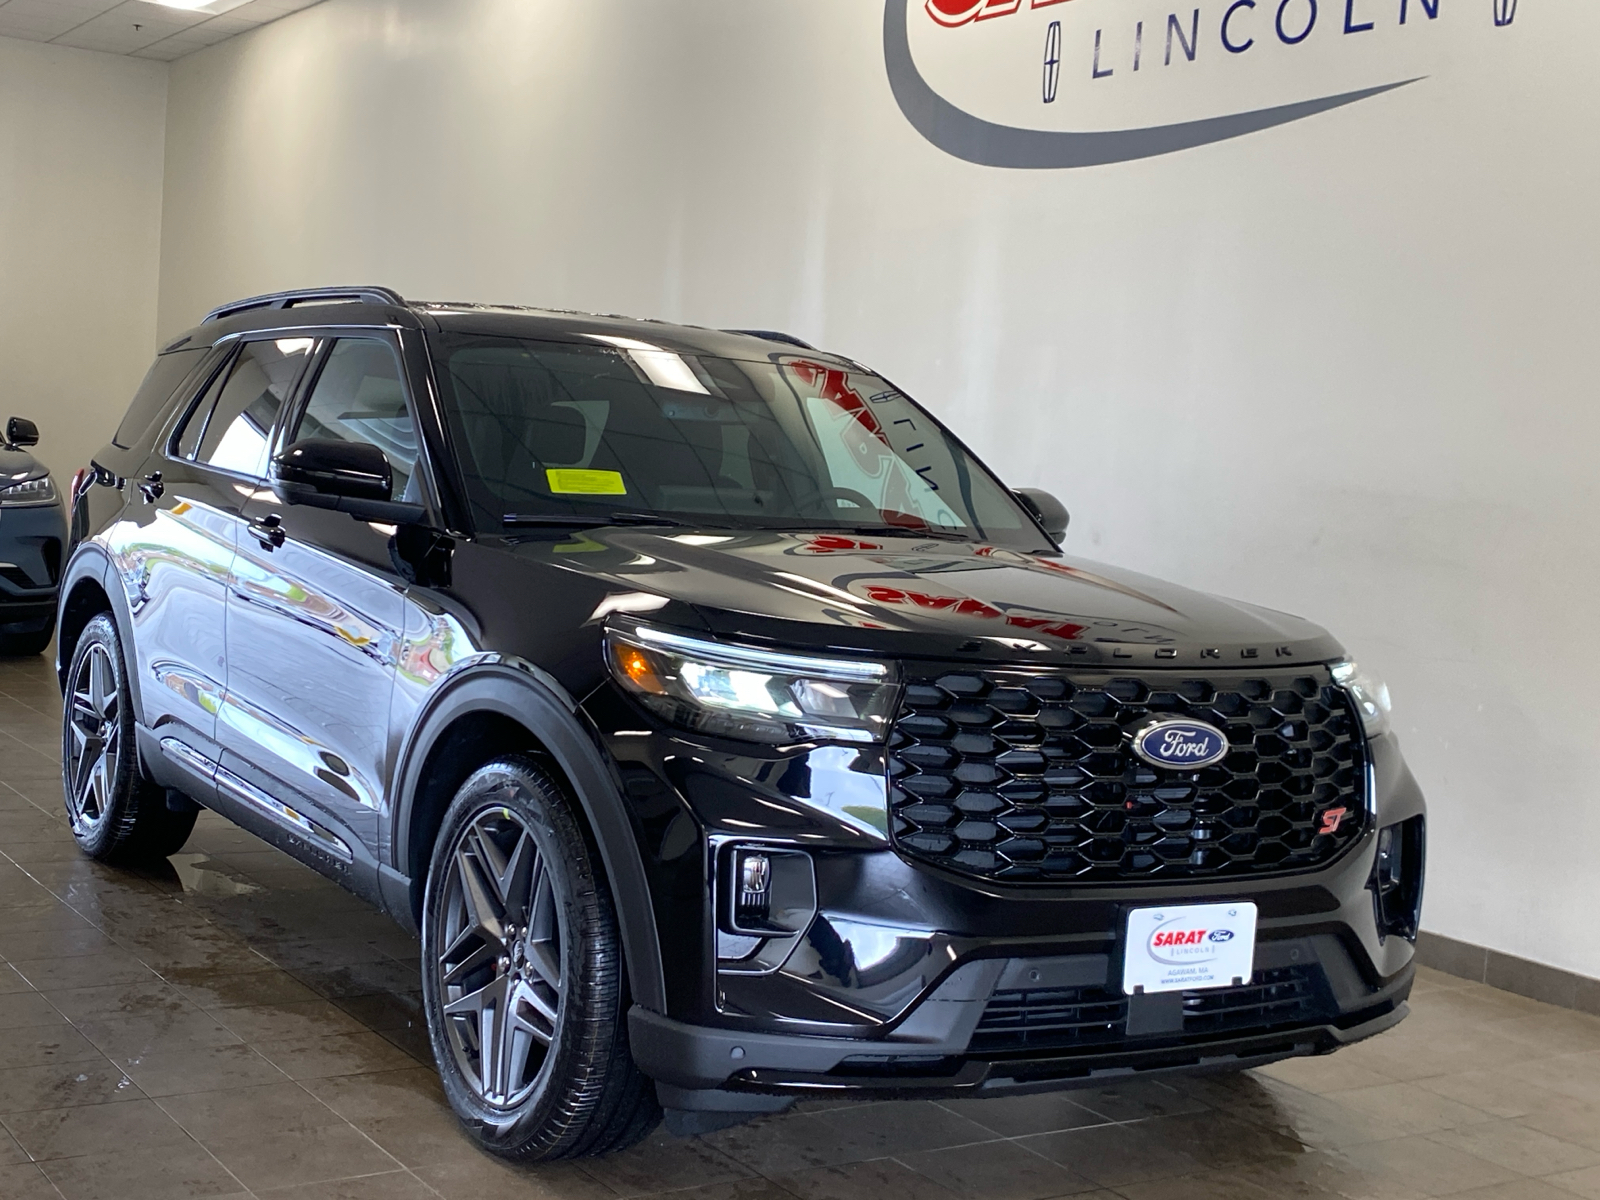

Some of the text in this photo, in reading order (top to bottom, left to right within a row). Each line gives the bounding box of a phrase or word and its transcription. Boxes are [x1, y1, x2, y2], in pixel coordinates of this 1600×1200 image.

[956, 640, 1292, 659] EXPLORER
[1159, 729, 1209, 757] Ford
[1319, 806, 1347, 834] ST
[1153, 930, 1231, 947] SARAT Ford
[1176, 947, 1209, 955] LINCOLN
